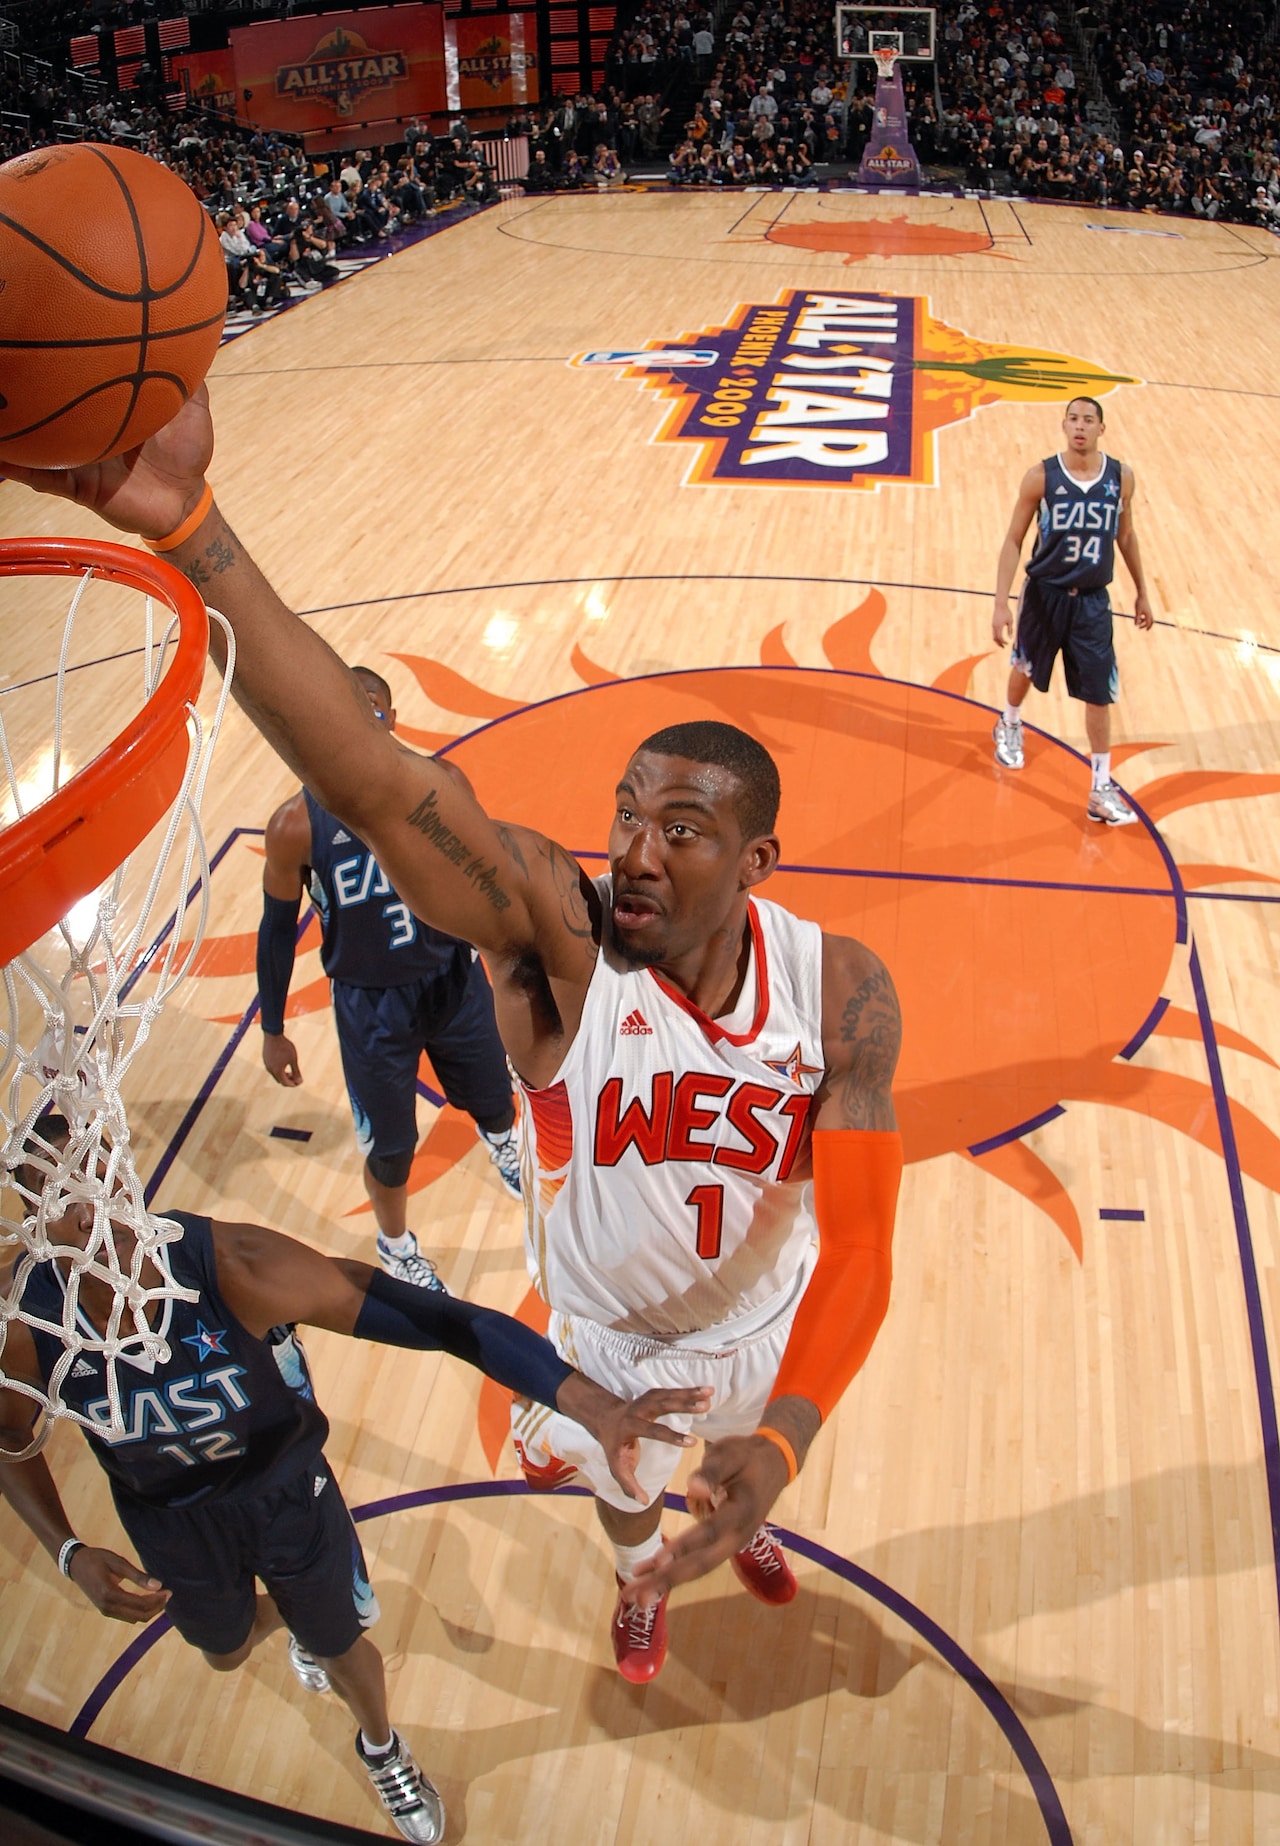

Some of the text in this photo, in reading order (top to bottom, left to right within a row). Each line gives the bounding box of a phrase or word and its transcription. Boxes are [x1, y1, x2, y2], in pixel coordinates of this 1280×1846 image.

[699, 310, 789, 427] PHOENIX 2009
[1051, 501, 1116, 531] EAST
[1063, 535, 1101, 565] 34
[840, 969, 888, 1043] NOBODY
[593, 1071, 814, 1183] WEST
[685, 1184, 724, 1260] 1
[83, 1364, 251, 1447] EAST
[158, 1431, 247, 1467] 12
